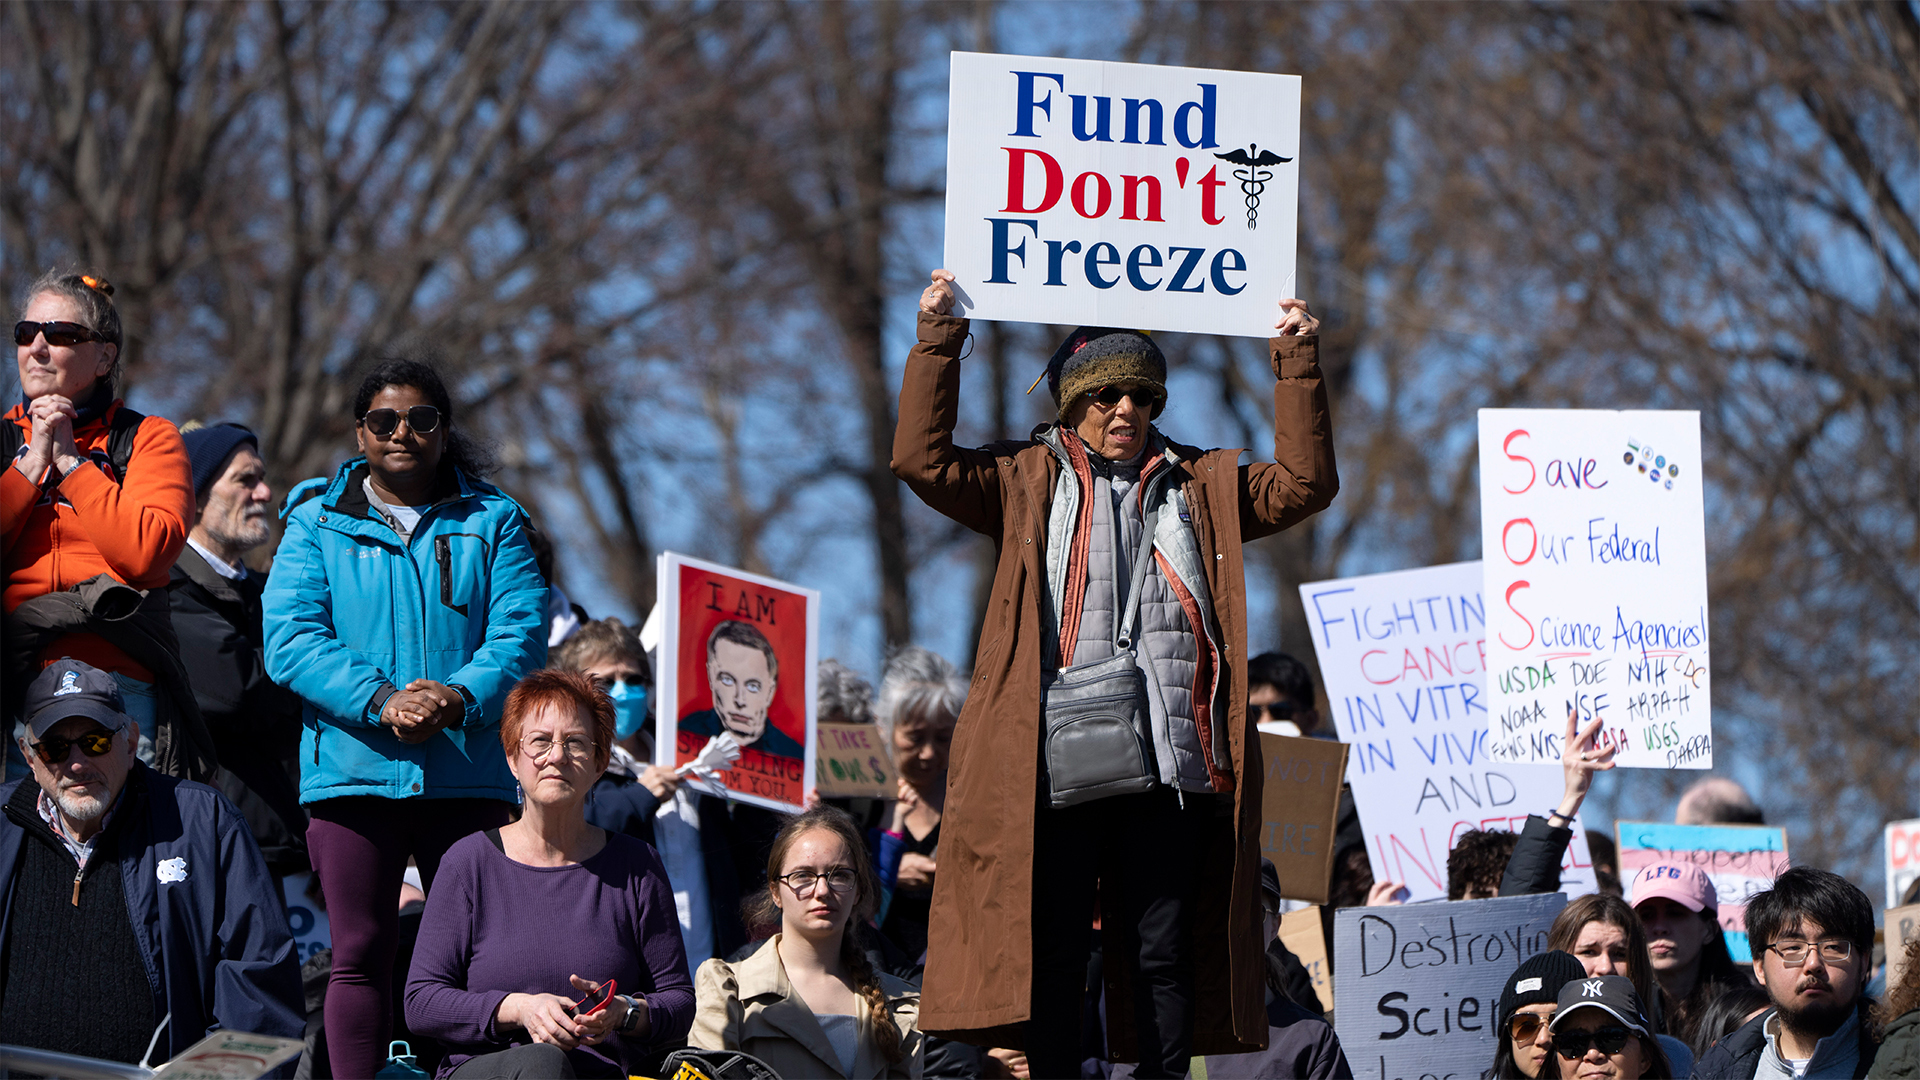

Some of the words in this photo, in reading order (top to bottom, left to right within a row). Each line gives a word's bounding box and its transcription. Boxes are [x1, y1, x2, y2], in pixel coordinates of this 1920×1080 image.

[1008, 70, 1220, 149] Fund
[998, 147, 1226, 225] Don't
[983, 217, 1248, 295] Freeze
[1503, 429, 1608, 495] Save
[1503, 517, 1574, 566] Our
[1588, 517, 1660, 566] Federal
[706, 581, 724, 612] I
[734, 590, 776, 625] AM
[1312, 587, 1486, 648] FIGHTIN
[1499, 580, 1605, 651] Science
[1612, 606, 1707, 671] Agencies!
[1360, 639, 1486, 685] CANC
[1499, 660, 1556, 694] USDA
[1570, 658, 1612, 687] DOE
[1627, 656, 1668, 688] NIH
[1345, 693, 1385, 733] IN
[1396, 683, 1487, 724] VITR
[1500, 699, 1547, 738] NOAA
[1566, 690, 1611, 721] NSF
[1626, 684, 1690, 721] ARPA-H
[678, 731, 802, 782] STLING
[1357, 739, 1396, 774] IN
[1591, 727, 1630, 754] NASA
[1643, 721, 1680, 751] USGS
[1667, 734, 1710, 770] DARPA
[1415, 772, 1516, 814] AND
[1262, 821, 1319, 855] IRE
[1646, 866, 1682, 882] LFG
[1359, 914, 1549, 977] Destroyin
[1581, 979, 1604, 997] NY
[1378, 992, 1499, 1039] Scie
